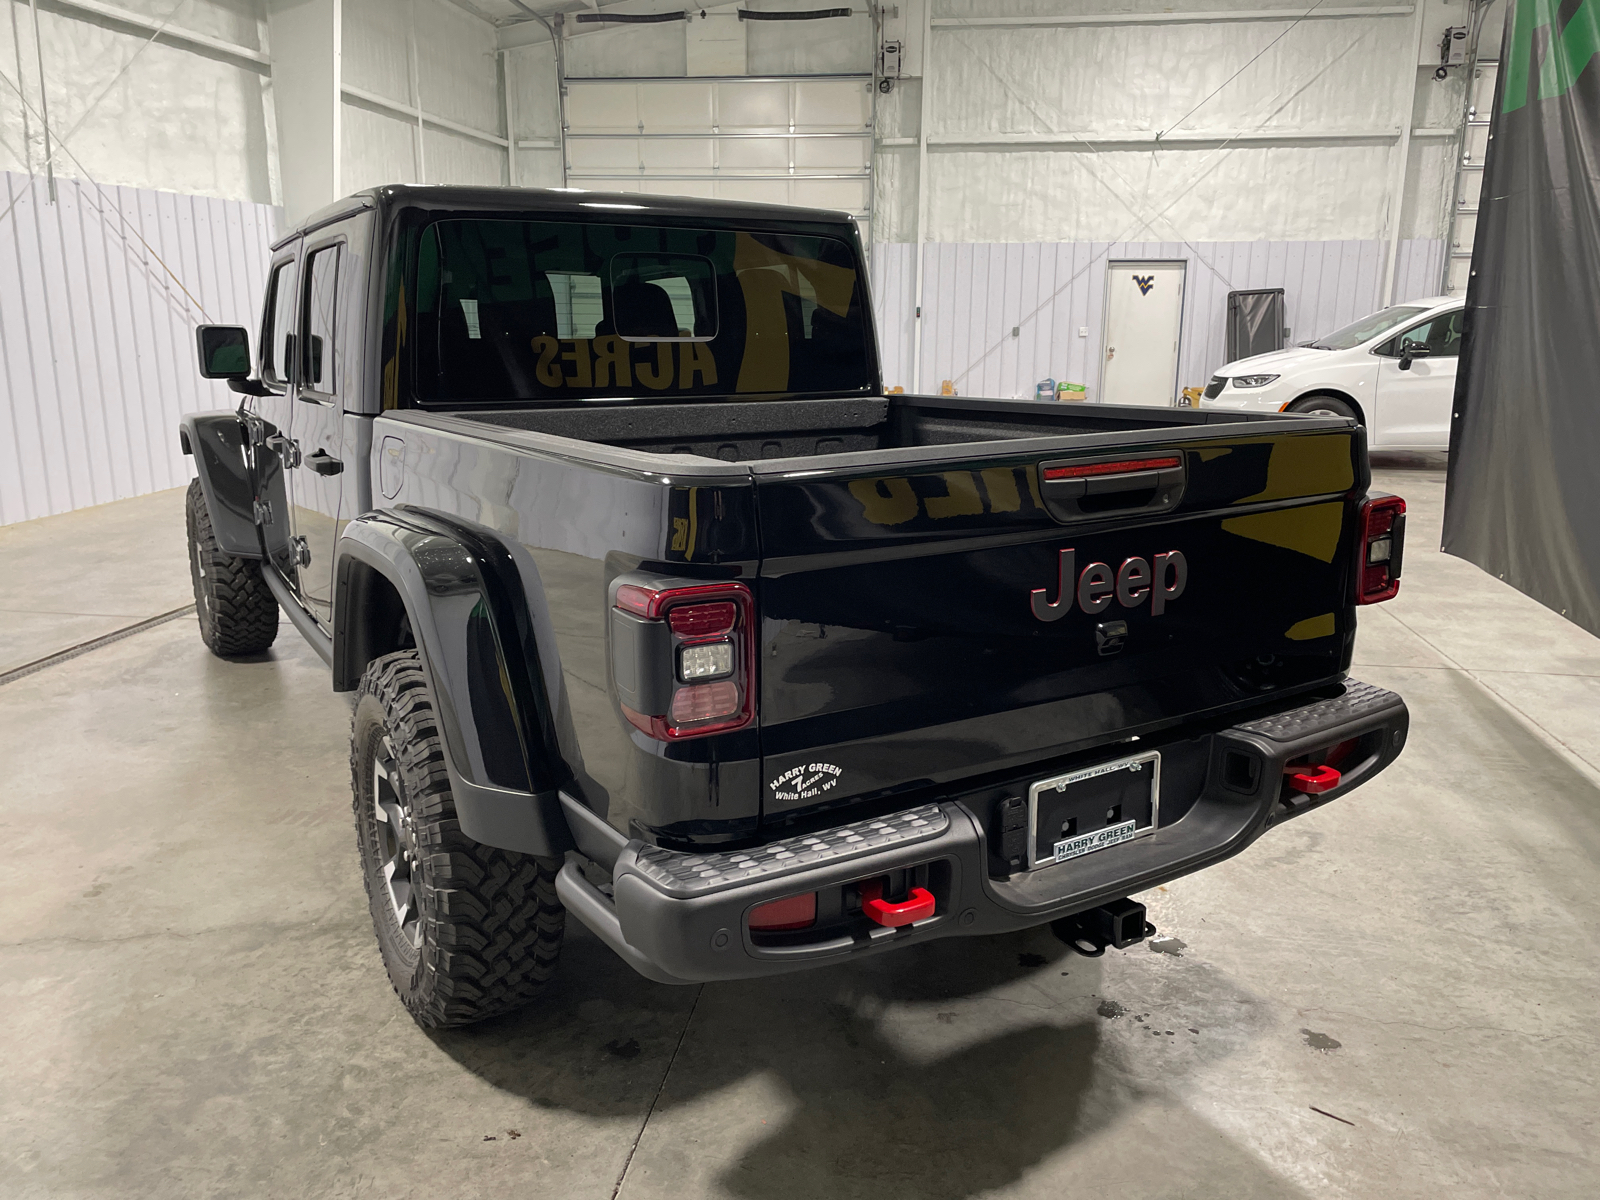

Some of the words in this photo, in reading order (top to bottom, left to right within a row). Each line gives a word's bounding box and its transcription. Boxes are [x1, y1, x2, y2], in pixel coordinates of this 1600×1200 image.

[1031, 548, 1188, 622] Jeep
[770, 764, 806, 790] HARRY
[808, 763, 842, 777] GREEN
[791, 775, 803, 792] 7
[802, 772, 824, 789] ACRES
[1068, 772, 1093, 782] WHITE
[775, 791, 799, 800] White
[800, 787, 821, 799] Hall,
[822, 778, 837, 791] WV
[1057, 835, 1096, 855] HARRY
[1099, 824, 1134, 842] GREEN
[1087, 841, 1105, 852] DODGE
